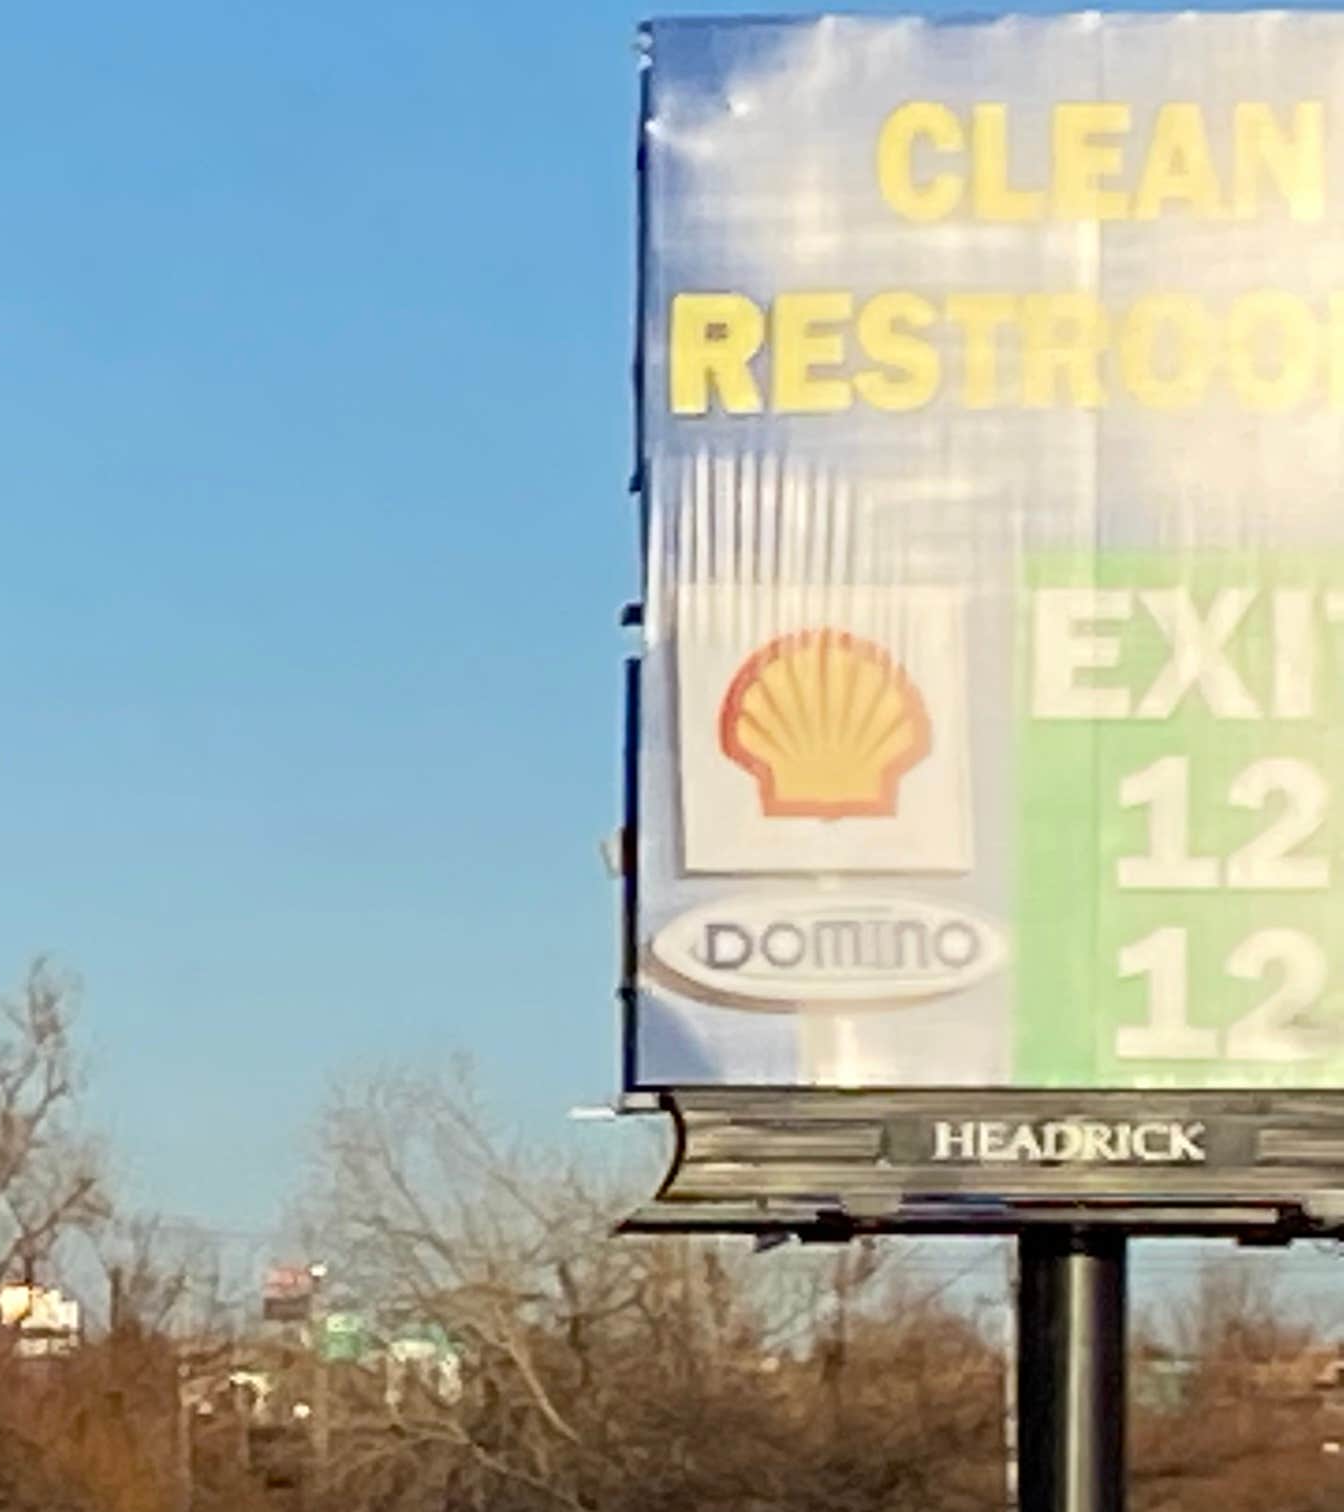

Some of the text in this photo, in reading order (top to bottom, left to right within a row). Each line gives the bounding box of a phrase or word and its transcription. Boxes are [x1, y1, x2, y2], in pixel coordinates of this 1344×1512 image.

[876, 101, 1324, 222] CLEAN
[670, 292, 1344, 415] RESTROO
[1031, 586, 1344, 719] EXI
[1117, 753, 1330, 889] 12
[933, 1121, 1206, 1161] HEADRICK
